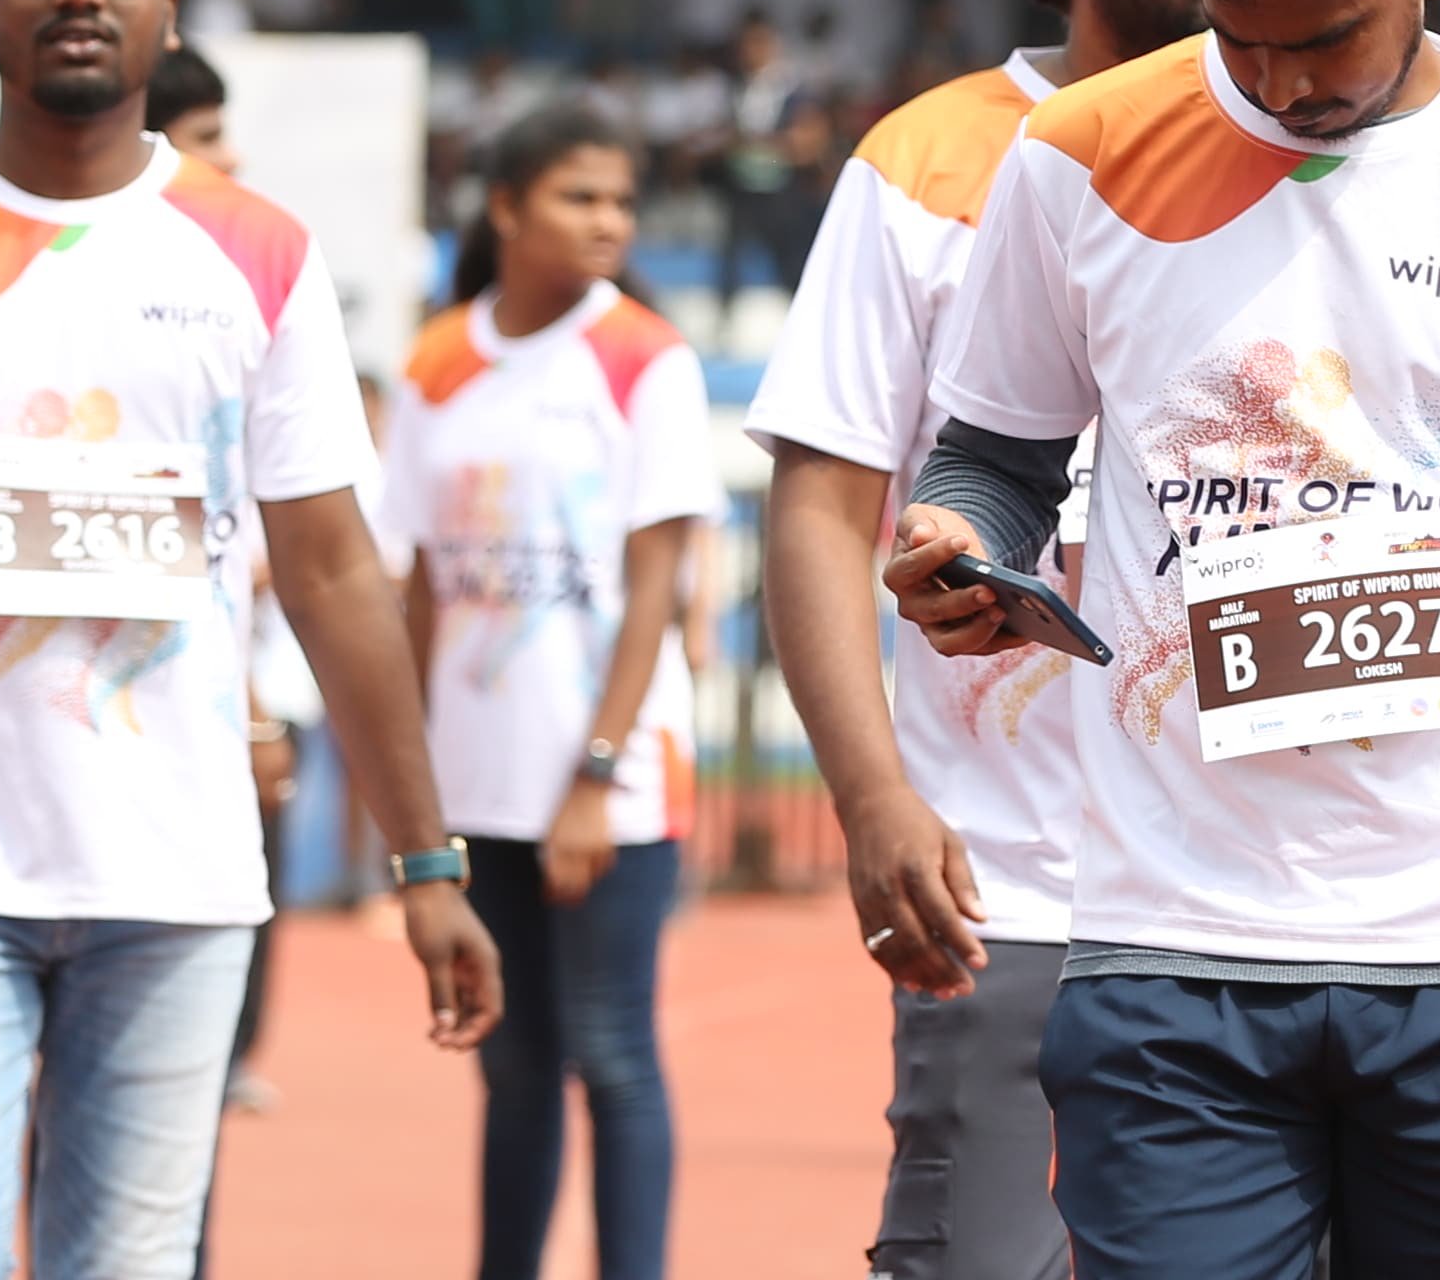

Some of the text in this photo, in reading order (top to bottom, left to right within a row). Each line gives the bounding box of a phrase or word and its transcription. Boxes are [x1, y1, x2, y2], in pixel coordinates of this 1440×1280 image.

[140, 301, 235, 331] wipro
[1148, 477, 1284, 516] PIRIT
[1297, 480, 1376, 514] OF
[50, 510, 185, 565] 2616
[1198, 553, 1255, 579] wipro
[1293, 583, 1339, 605] SPIRIT
[1342, 579, 1361, 598] OF
[1363, 573, 1411, 595] WIPRO
[1208, 610, 1261, 632] MARATHON
[1220, 600, 1245, 616] HALF
[1220, 632, 1259, 694] B
